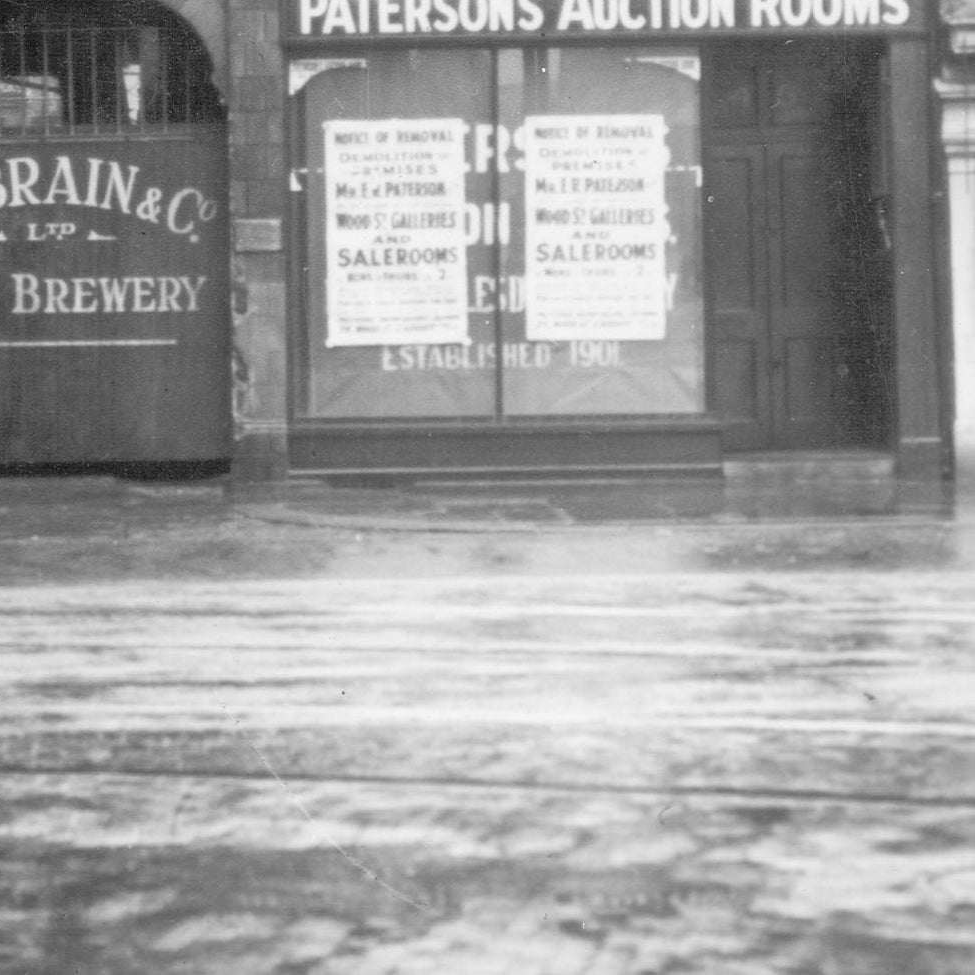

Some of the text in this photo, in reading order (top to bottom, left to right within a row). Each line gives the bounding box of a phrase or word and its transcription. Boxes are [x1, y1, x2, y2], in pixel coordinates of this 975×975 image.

[396, 129, 455, 143] REMOVAL
[135, 186, 162, 225] &
[373, 234, 412, 245] AND
[571, 230, 611, 240] AND
[336, 246, 459, 268] SALEROOMS
[535, 242, 657, 263] SALEROOMS
[10, 272, 208, 315] BREWERY
[381, 342, 552, 371] ESTABLISHED
